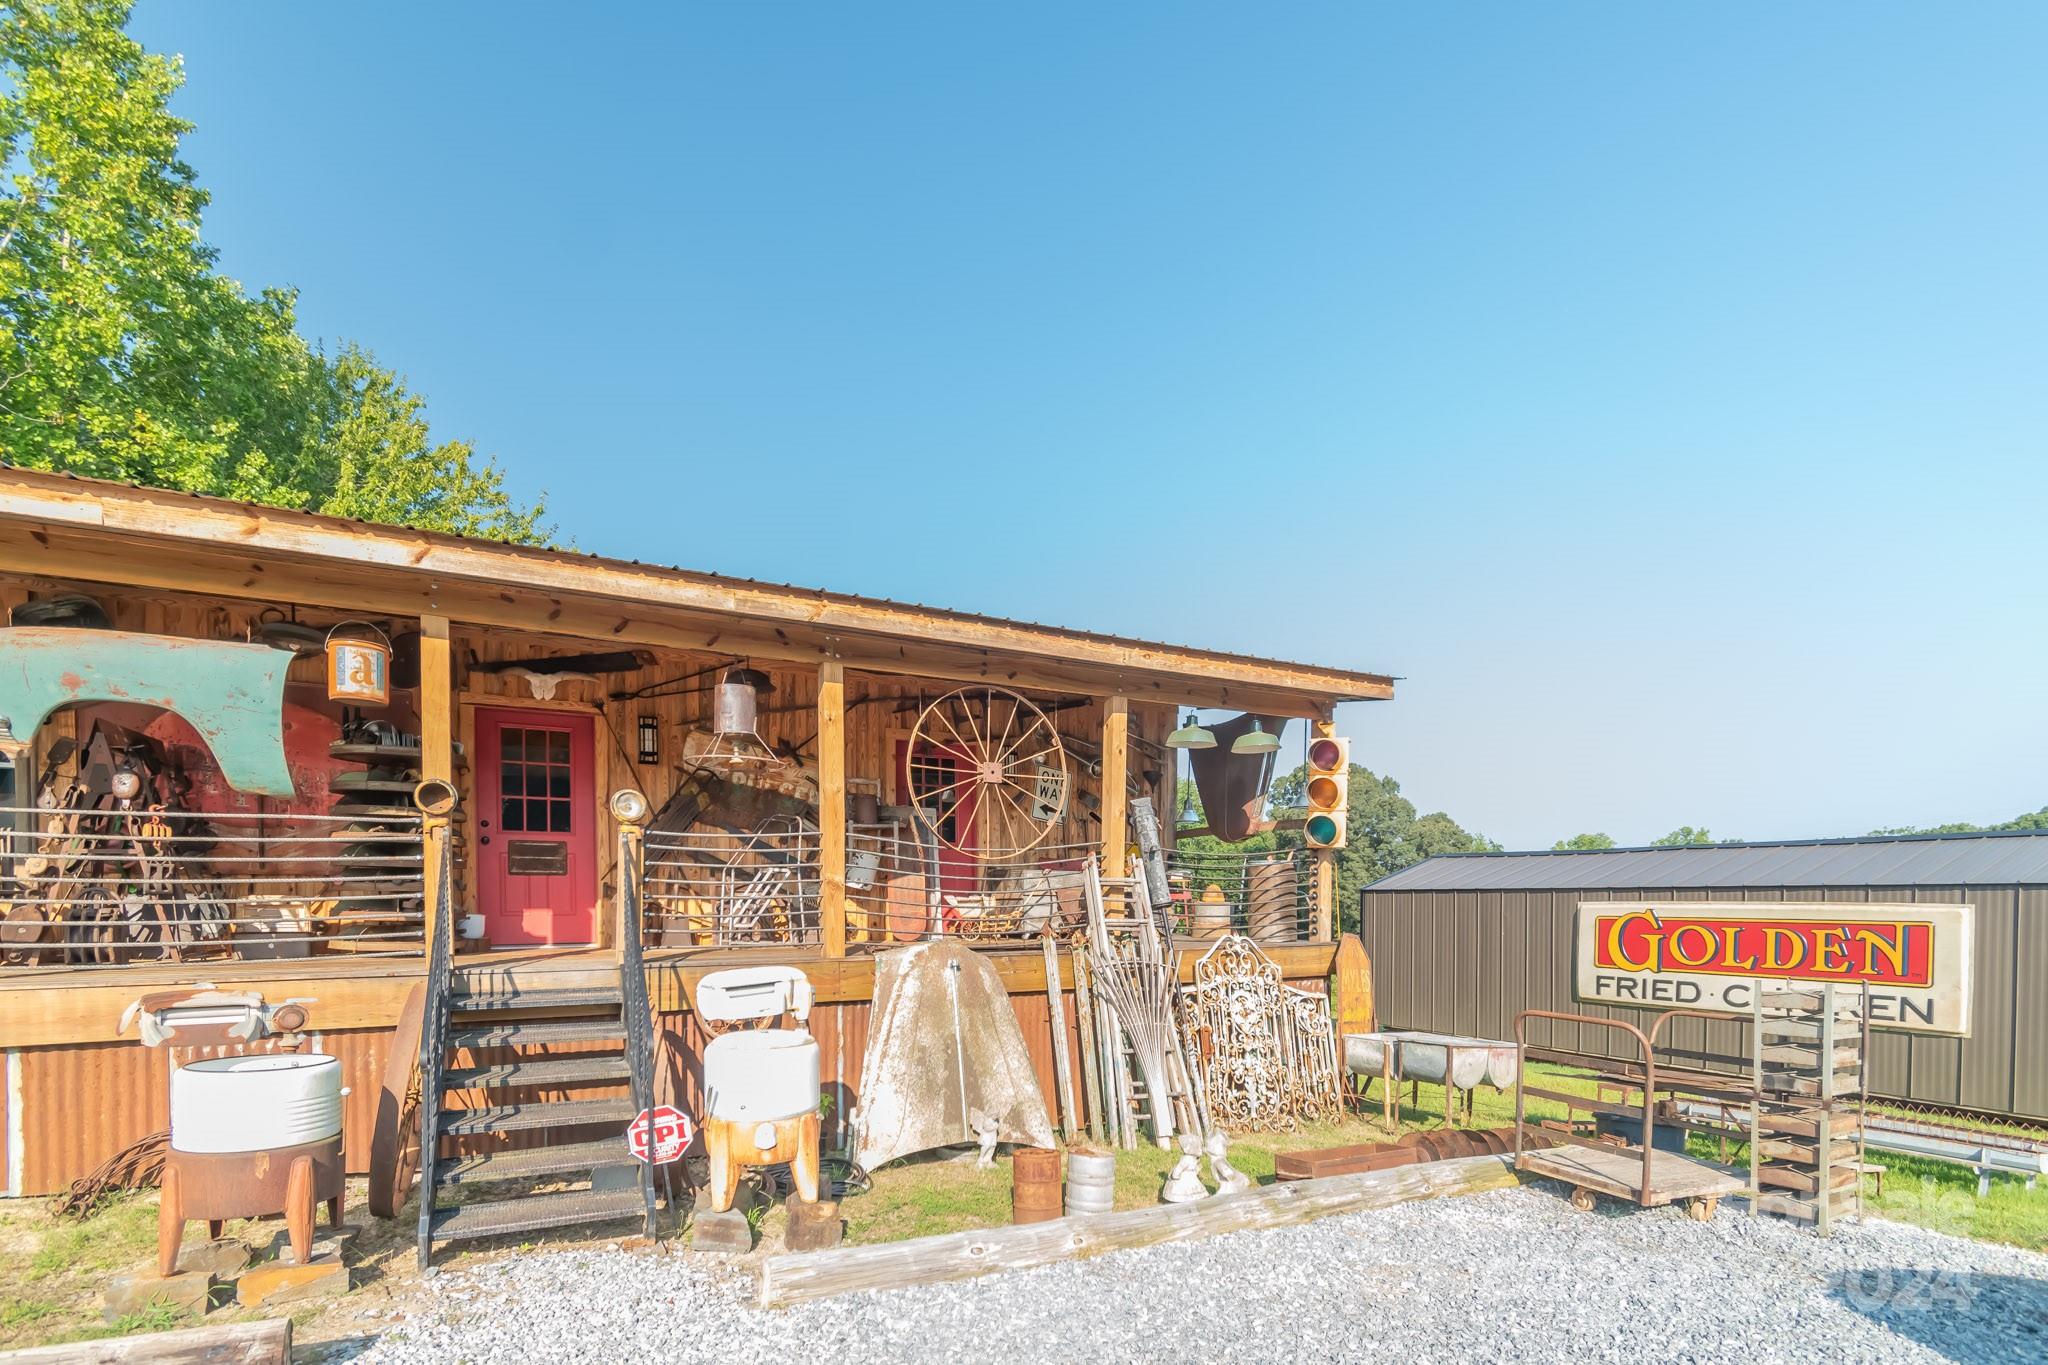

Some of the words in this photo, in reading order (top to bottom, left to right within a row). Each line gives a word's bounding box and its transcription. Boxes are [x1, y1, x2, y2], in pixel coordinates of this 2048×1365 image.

[1041, 771, 1065, 786] ON
[1040, 785, 1064, 801] WA
[1608, 908, 1909, 977] GOLDEN
[1596, 975, 1702, 1003] FRIED
[637, 1114, 678, 1129] WRNING
[634, 1122, 688, 1147] CPI
